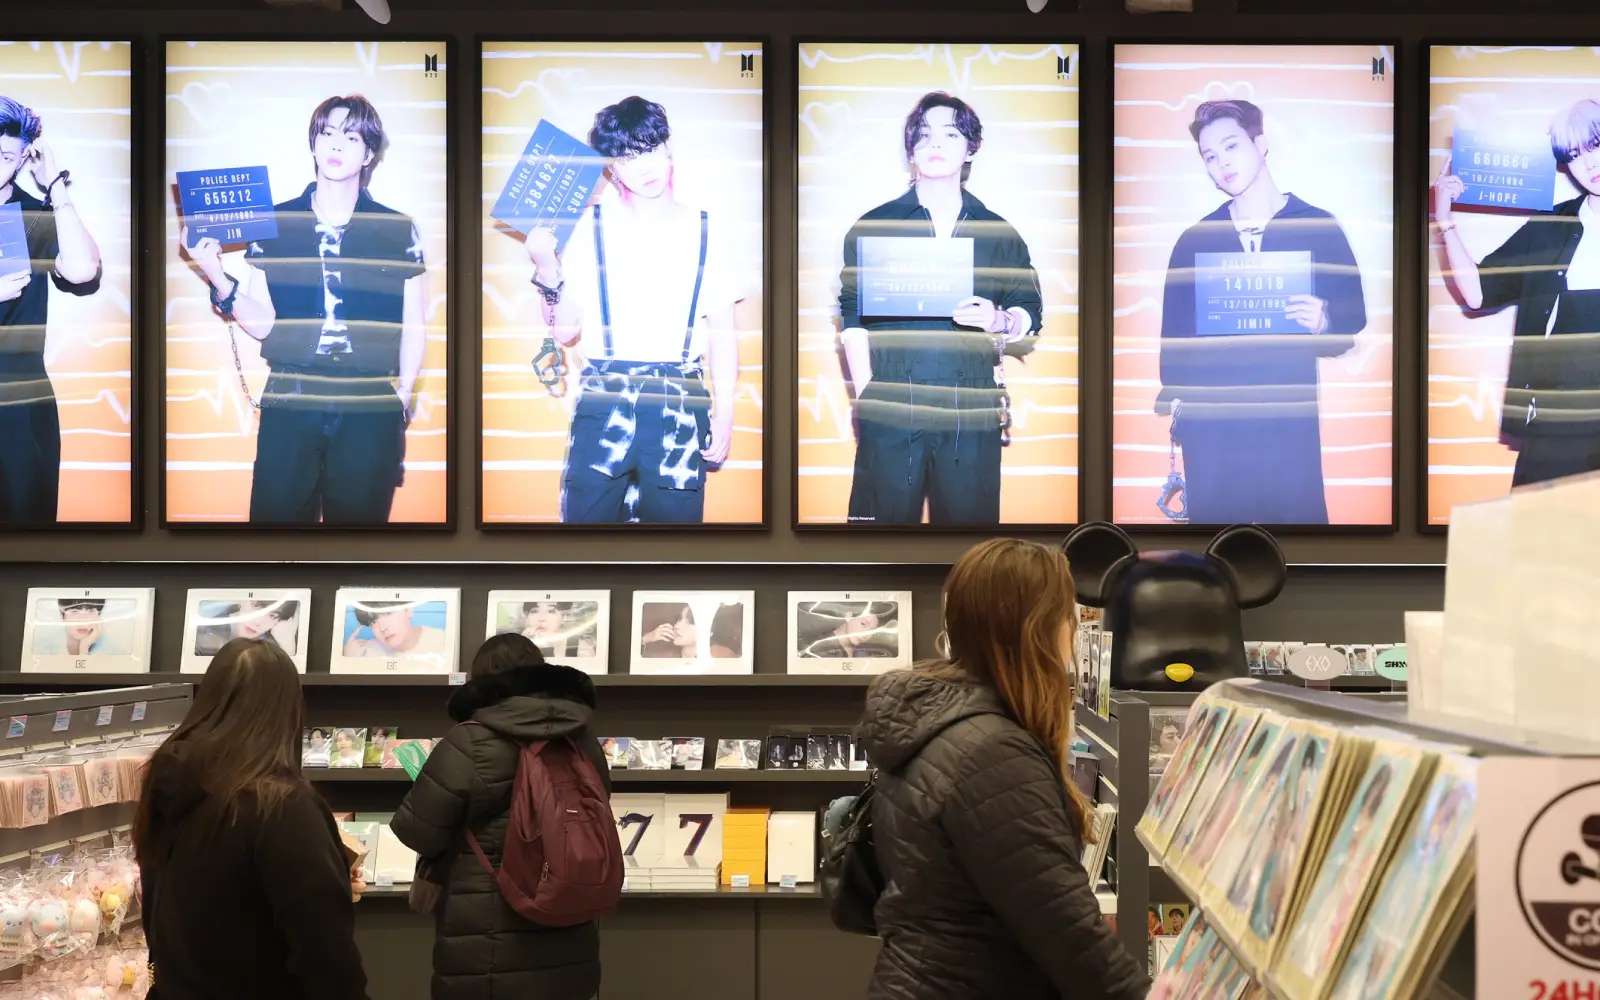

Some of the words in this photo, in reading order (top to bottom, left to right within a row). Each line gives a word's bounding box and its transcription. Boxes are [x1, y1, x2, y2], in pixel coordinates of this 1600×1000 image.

[508, 168, 531, 199] POLICE
[526, 143, 544, 166] DEPT
[200, 175, 228, 186] POLICE
[231, 173, 250, 183] DEPT
[204, 188, 252, 206] 655212
[547, 168, 576, 213] 9/3/1993
[1478, 190, 1518, 204] J-HOPE
[566, 185, 588, 213] SUGA
[227, 227, 242, 239] JIN
[1224, 276, 1284, 291] 141018
[1236, 317, 1271, 330] JIMIN
[75, 660, 87, 668] BE
[386, 661, 398, 670] BE
[1305, 655, 1331, 672] EXO
[678, 813, 714, 856] 7
[1529, 979, 1600, 1000] 24H
